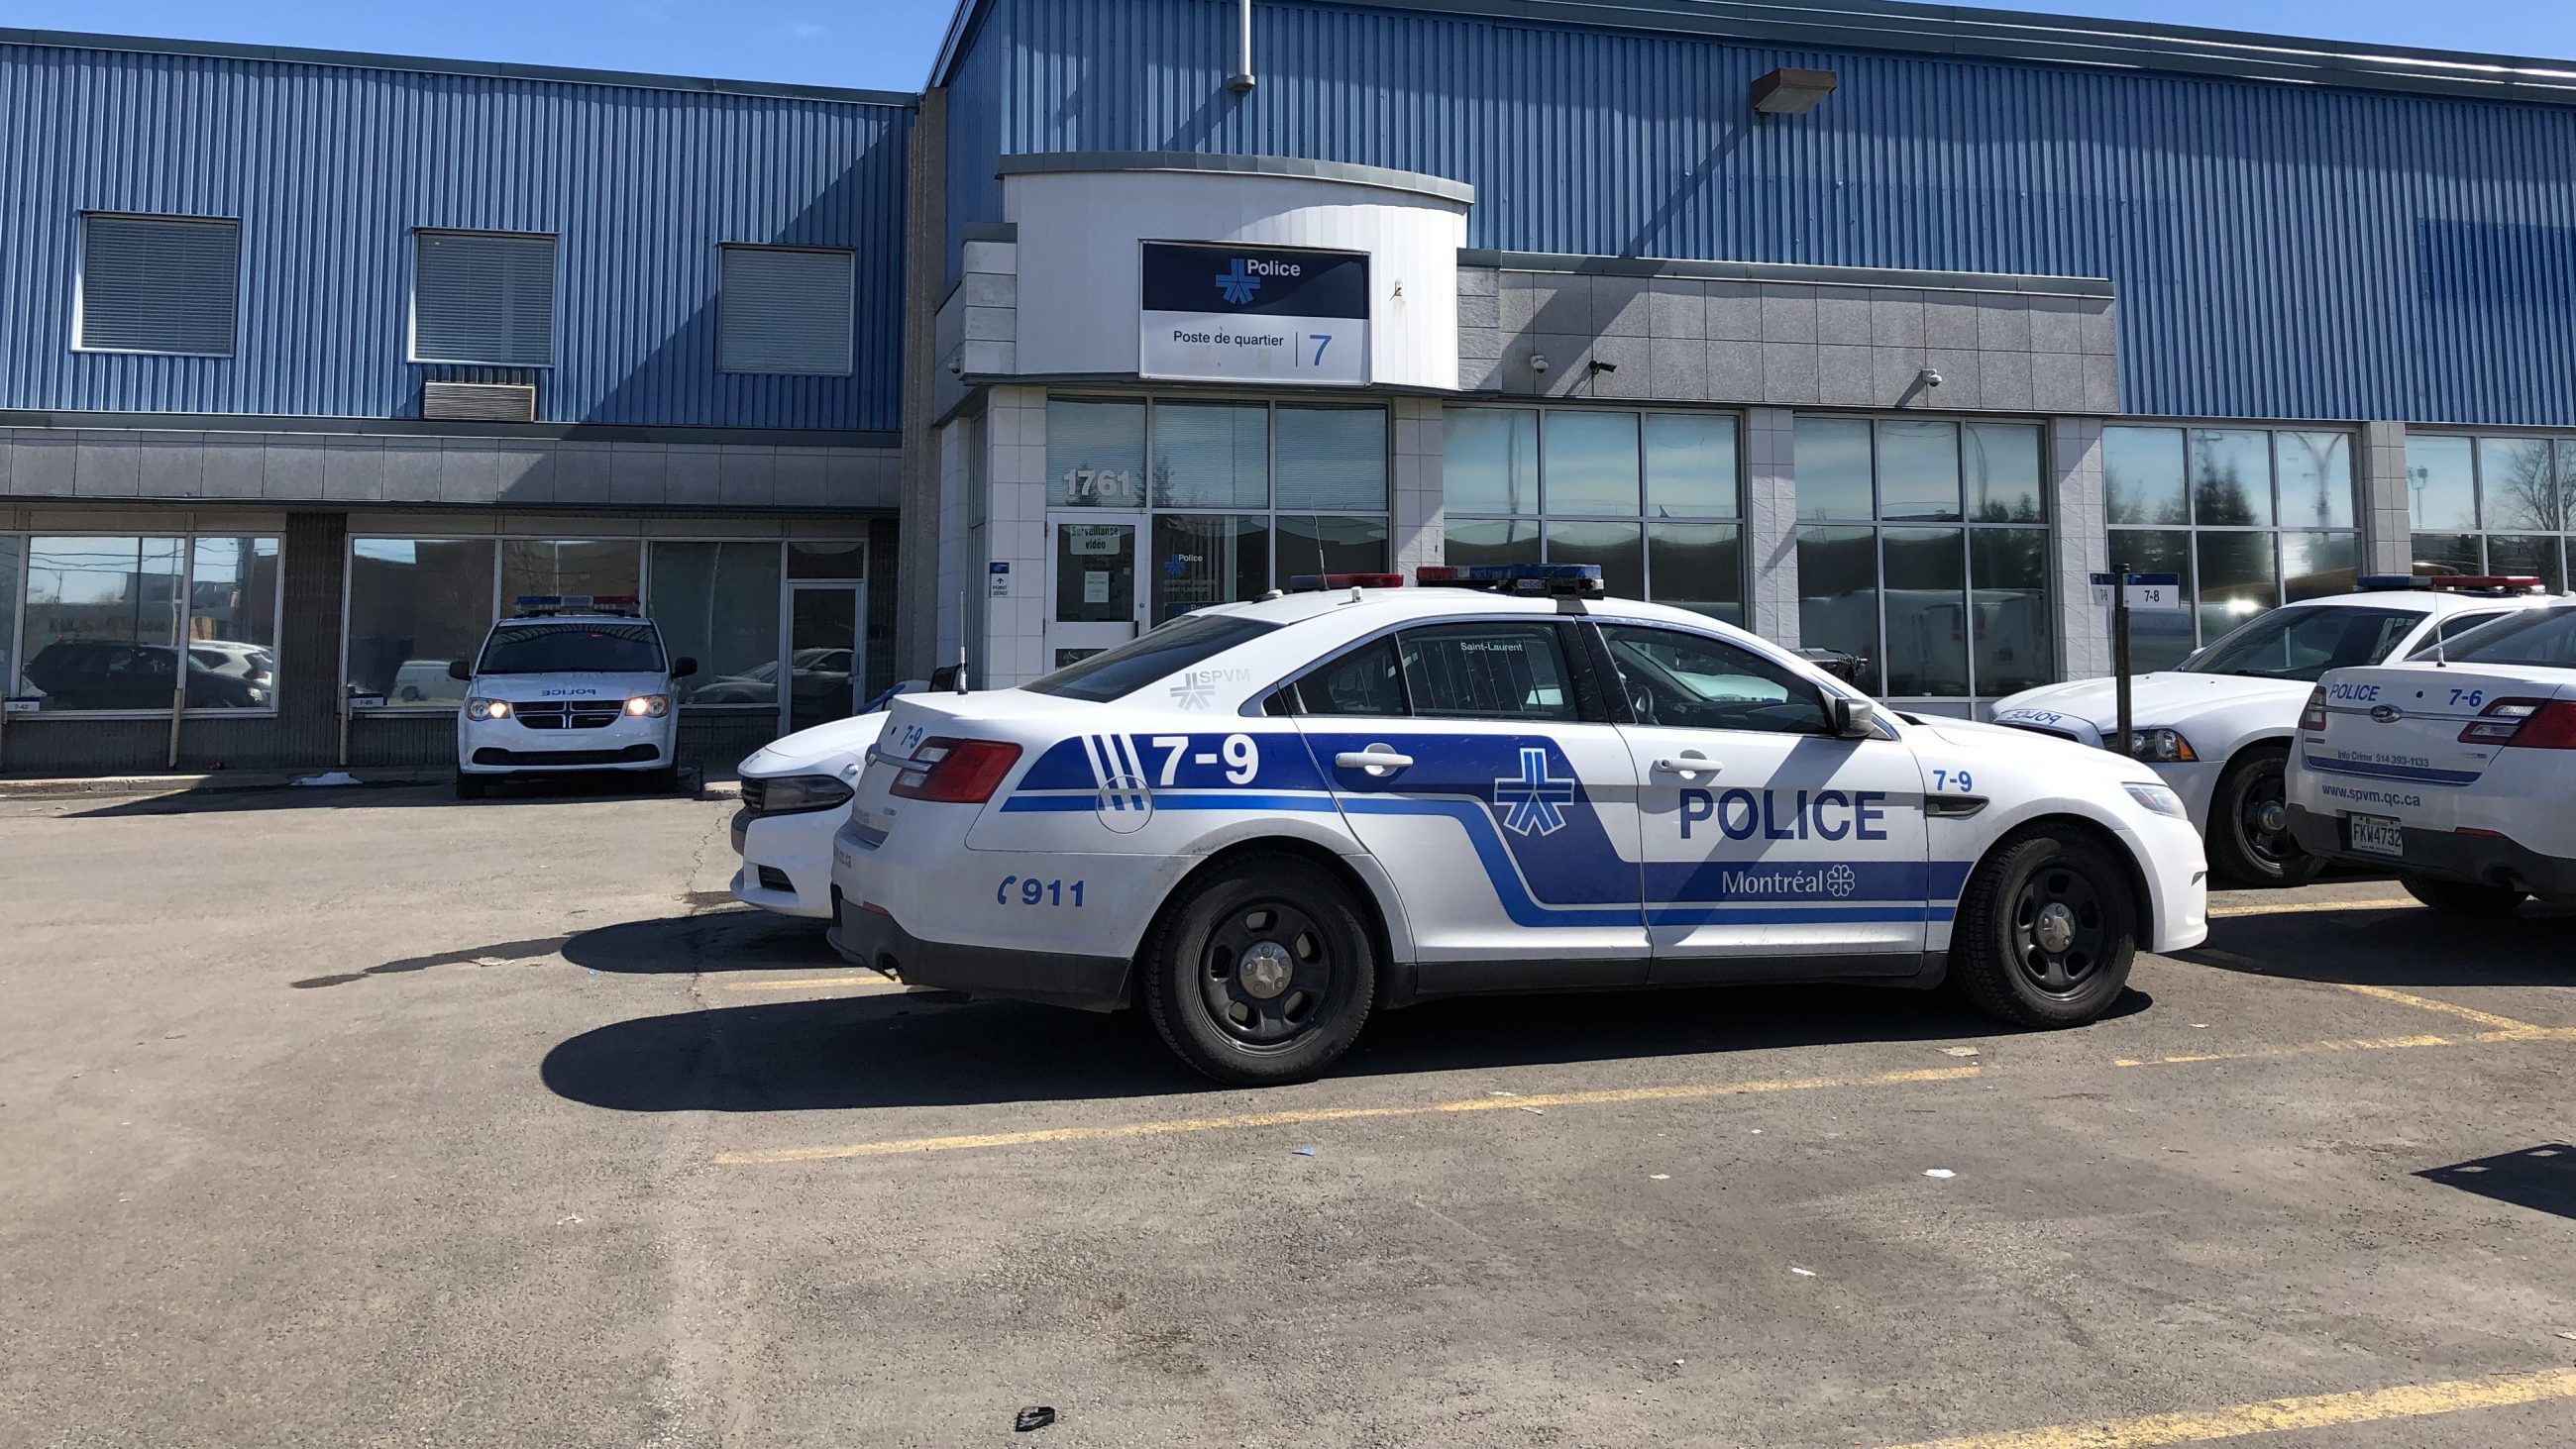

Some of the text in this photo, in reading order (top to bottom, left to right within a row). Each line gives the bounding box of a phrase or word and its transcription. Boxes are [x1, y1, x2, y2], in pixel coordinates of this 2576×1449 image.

[1246, 259, 1301, 277] Police
[1173, 330, 1333, 366] Poste de quartier 7
[1063, 468, 1130, 496] 1761
[1071, 525, 1119, 537] Surveillance
[1085, 538, 1107, 550] vidéo
[1178, 554, 1204, 563] Police
[2144, 589, 2160, 602] 7-8
[1459, 642, 1524, 652] Saint-Laurent
[1199, 668, 1251, 684] SPVM
[2328, 683, 2381, 702] POLICE
[2448, 688, 2483, 707] 7-6
[901, 724, 923, 749] 7-9
[1151, 733, 1259, 786] 7-9
[2337, 750, 2429, 768] Info Crime 514 393-1133
[1933, 770, 1973, 793] 7-9
[2321, 783, 2420, 807] www.spvm.qc.ca
[1678, 787, 1887, 842] POLICE
[2353, 823, 2402, 848] FKW4732
[1722, 870, 1823, 894] Montréal
[1021, 878, 1085, 908] 911
